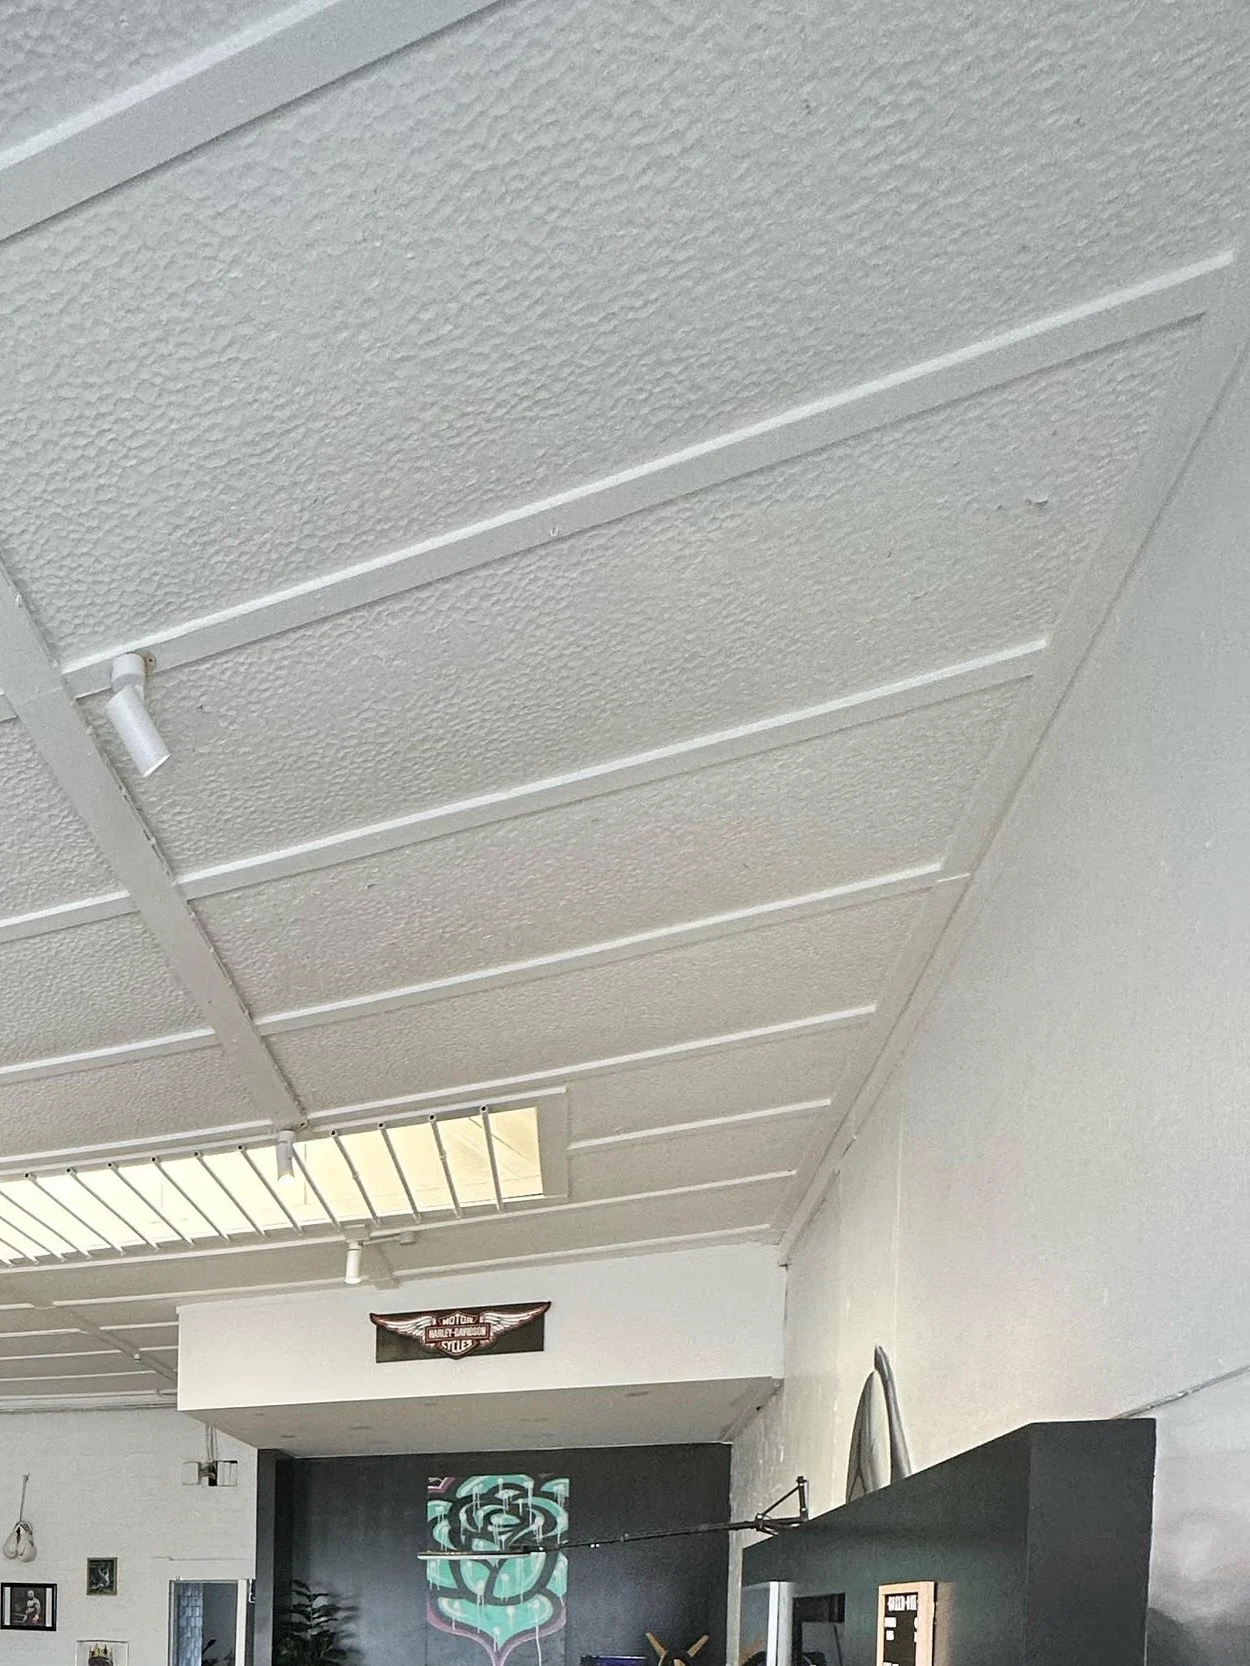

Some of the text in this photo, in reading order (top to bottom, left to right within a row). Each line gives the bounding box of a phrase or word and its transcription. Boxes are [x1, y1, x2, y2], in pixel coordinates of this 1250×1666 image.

[442, 1313, 474, 1325] MOTOR
[428, 1326, 487, 1339] HARLEY-DAVIDSON
[441, 1339, 473, 1353] CYCLES
